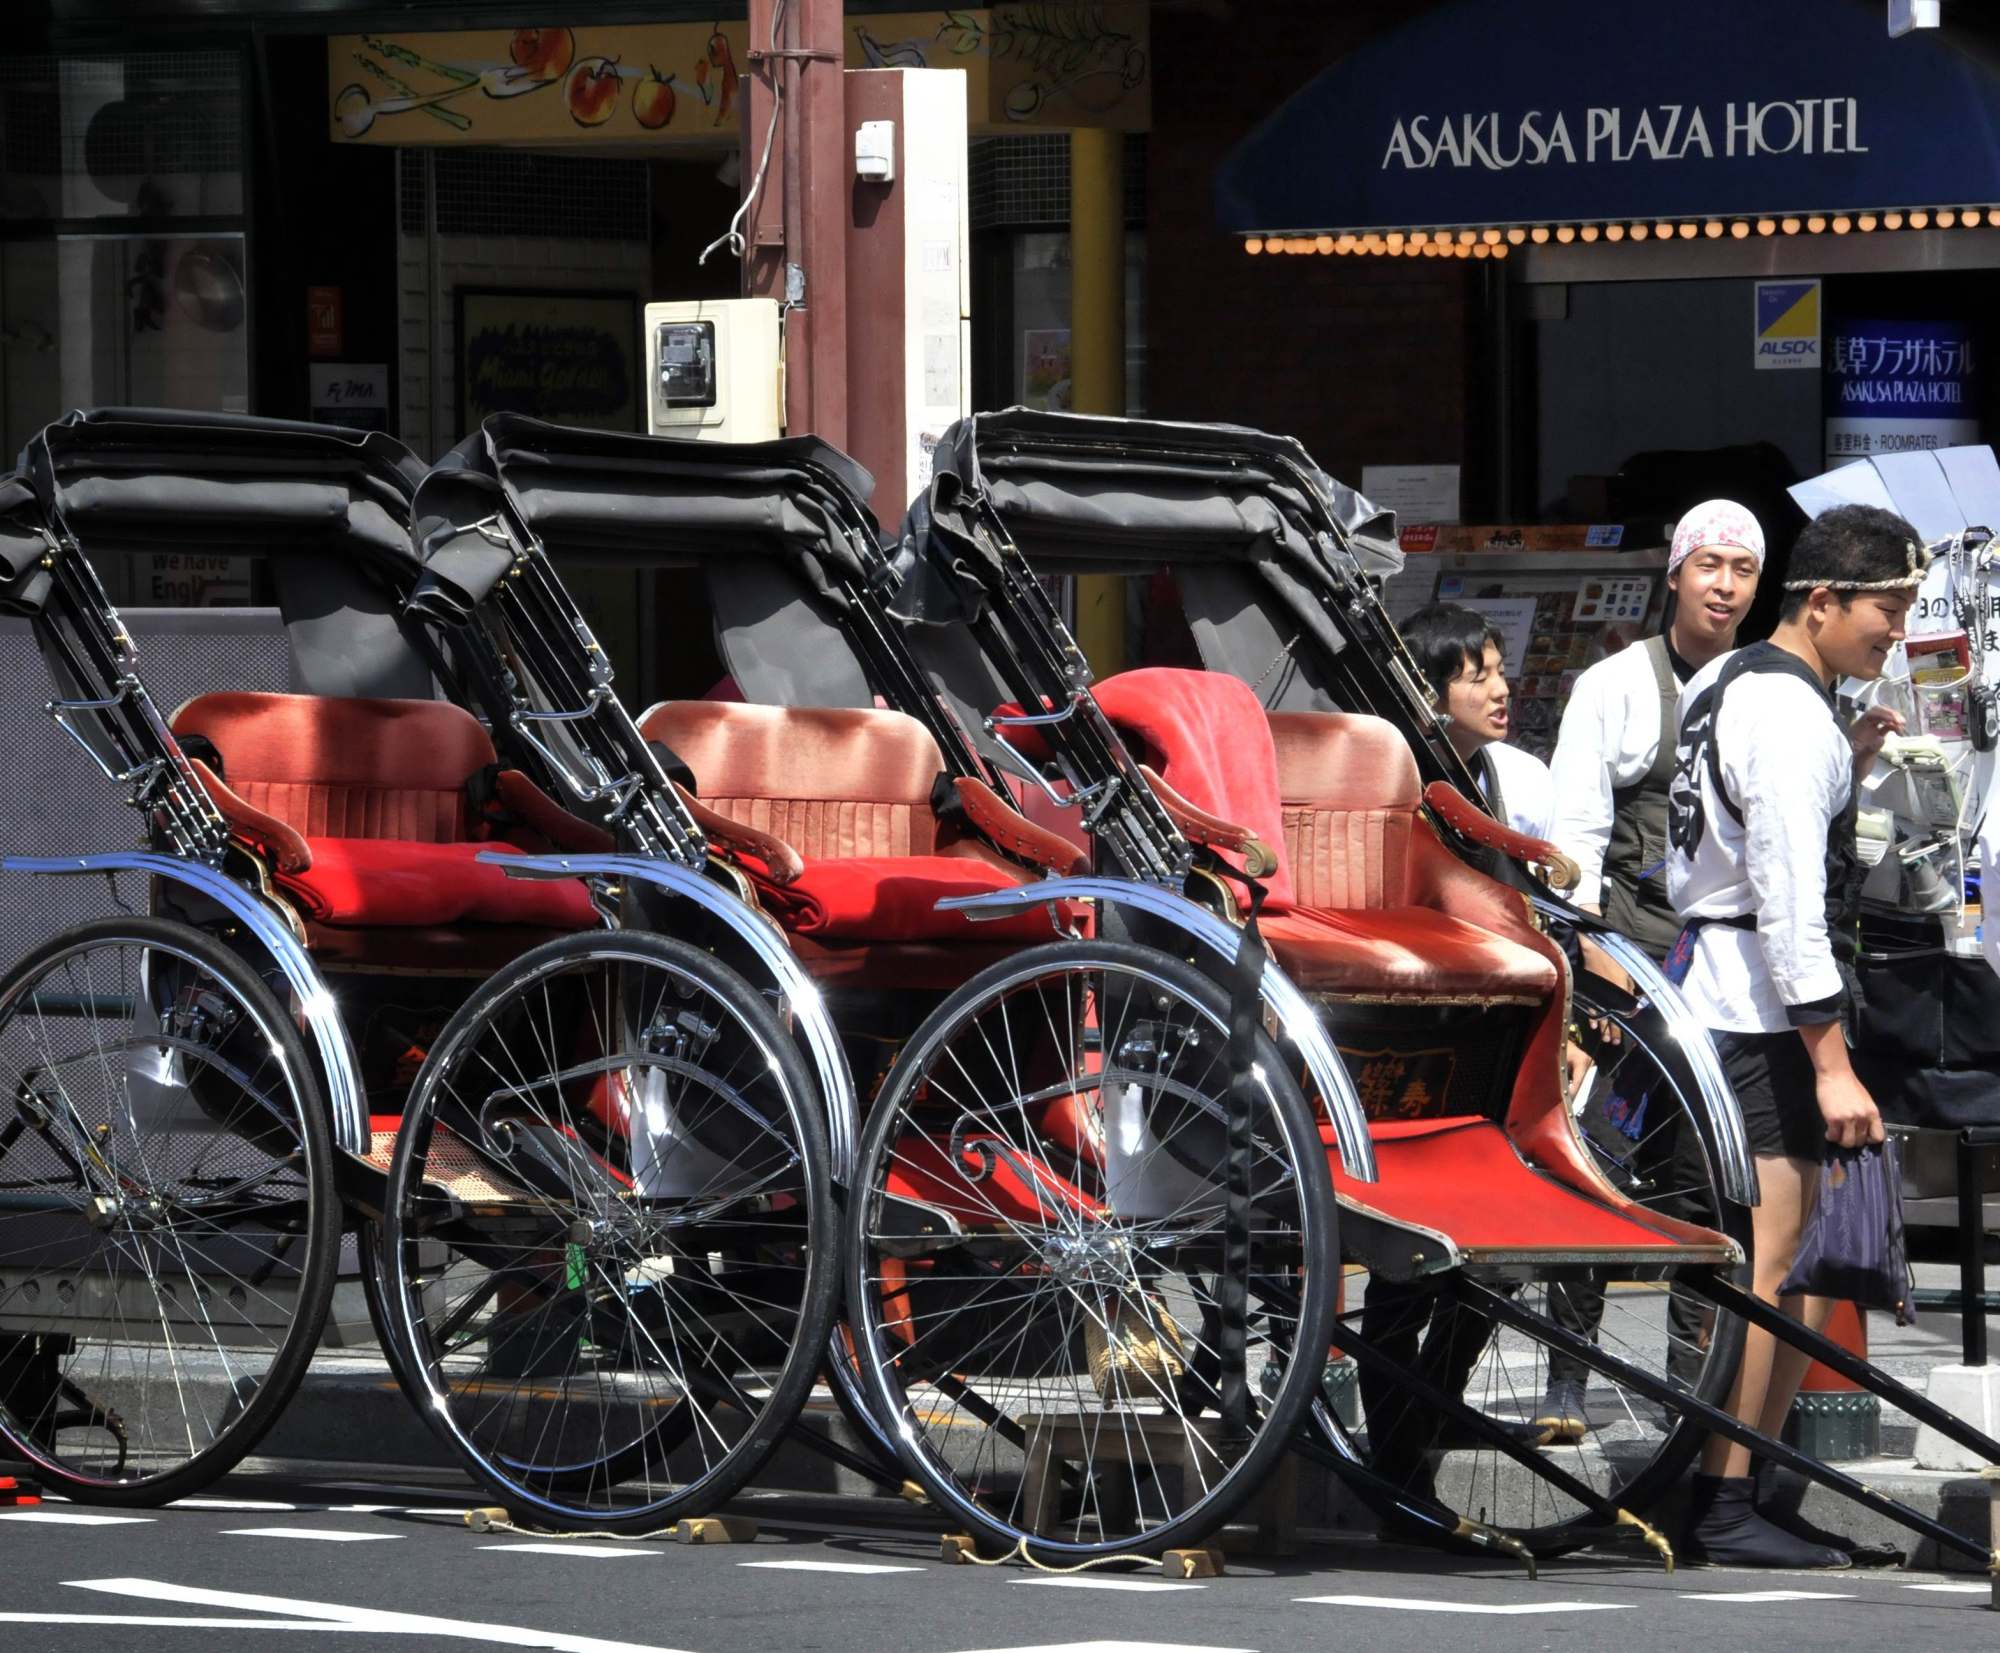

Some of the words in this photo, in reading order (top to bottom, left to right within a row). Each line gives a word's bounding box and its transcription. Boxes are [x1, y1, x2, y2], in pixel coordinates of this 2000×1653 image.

[1382, 111, 1577, 170] ASAKUSA
[1586, 105, 1715, 162] PLAZA
[1726, 97, 1869, 157] HOTEL
[1759, 340, 1817, 355] ALSOK
[1828, 336, 1976, 376] 浅草プラザホテル
[1841, 380, 1893, 403] ASAKUSA
[1893, 380, 1927, 403] PLAZA
[1928, 381, 1962, 404] HOTEL
